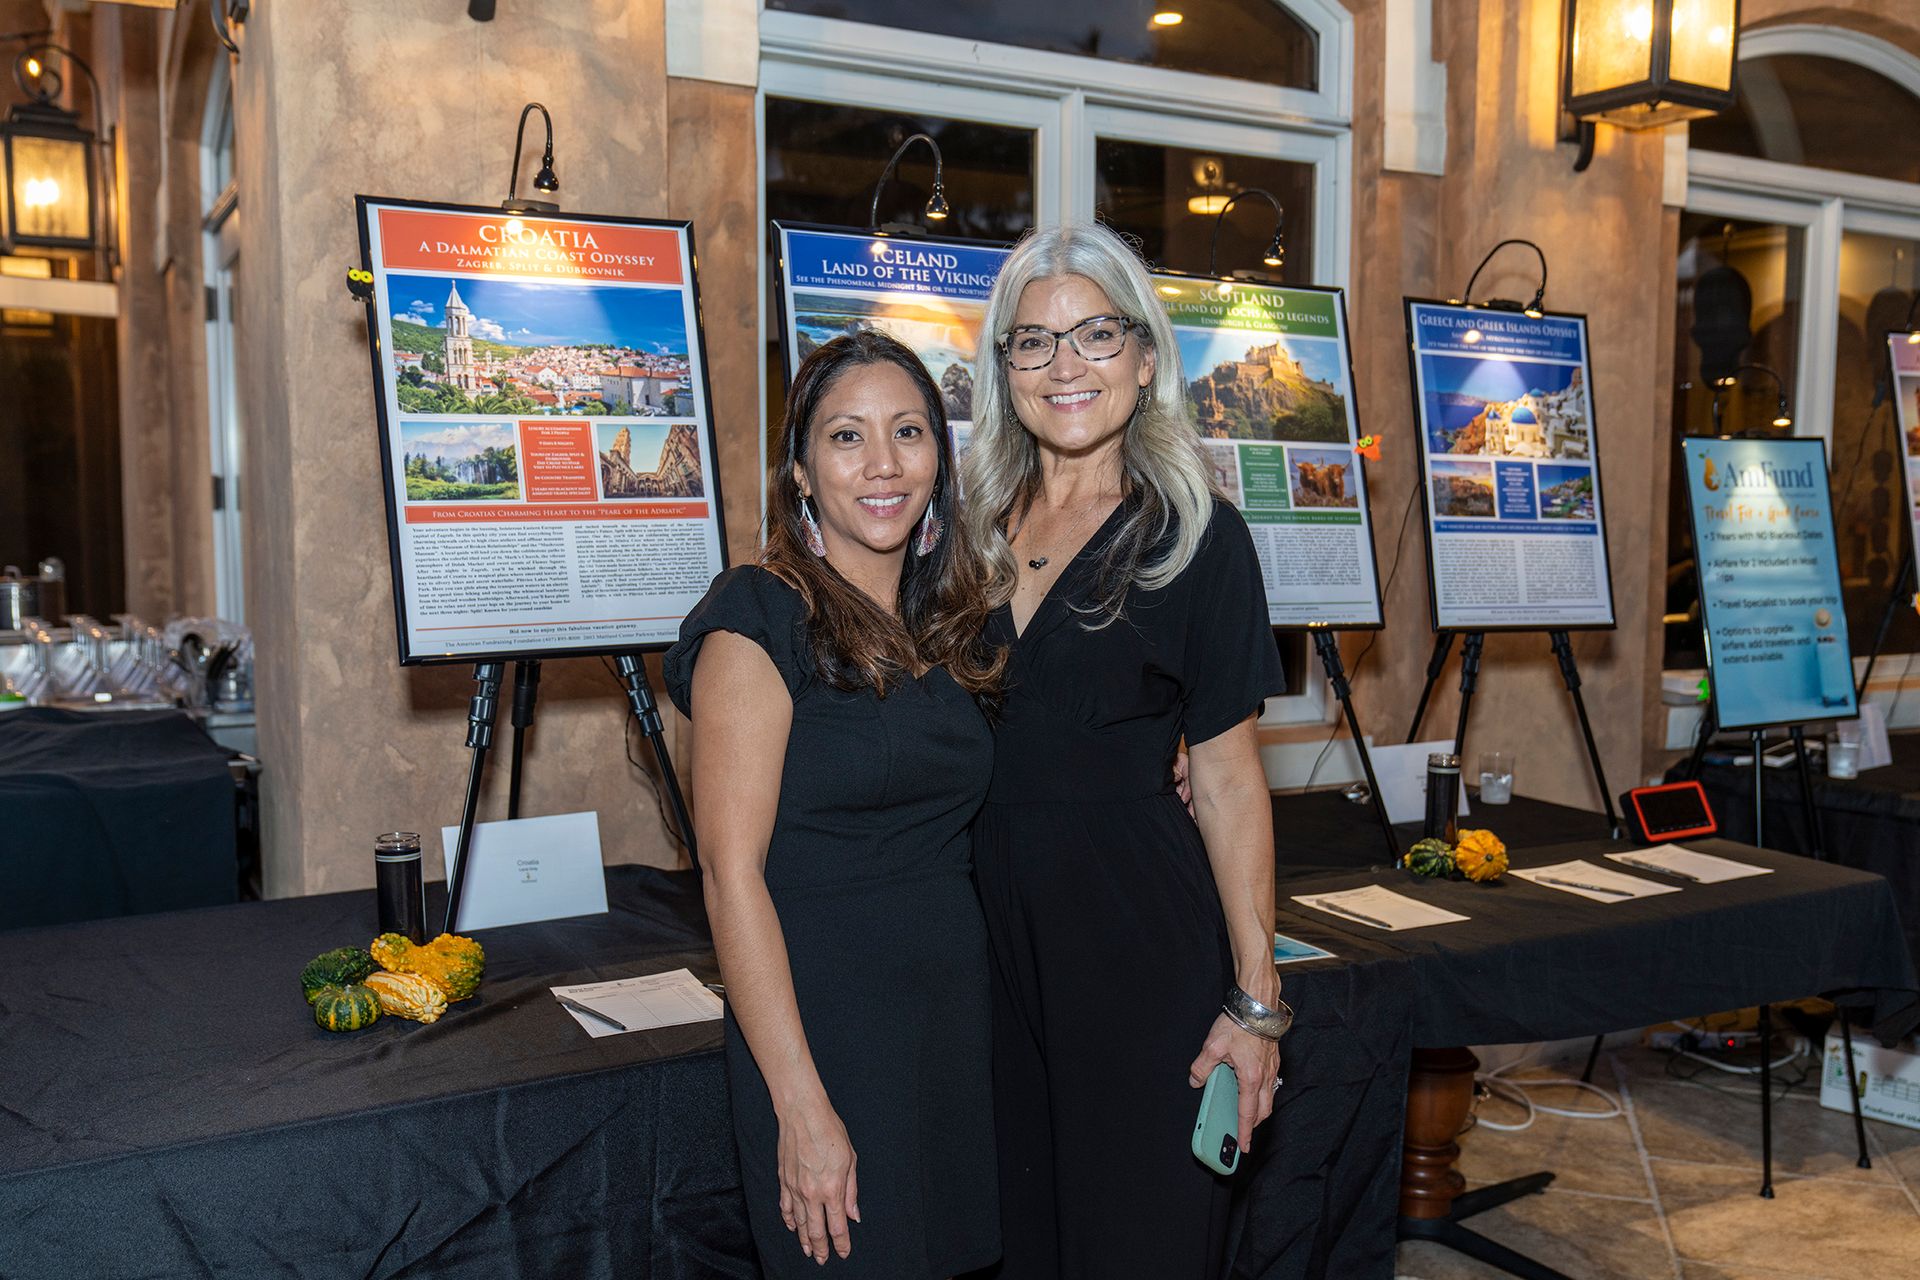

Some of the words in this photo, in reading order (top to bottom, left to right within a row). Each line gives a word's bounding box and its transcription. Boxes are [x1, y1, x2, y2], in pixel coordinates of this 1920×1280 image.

[478, 224, 600, 250] CROATIA
[419, 240, 431, 253] A
[436, 241, 529, 259] DALMATIAN
[535, 248, 586, 262] COAST
[590, 251, 655, 266] ODYSSEY
[872, 249, 958, 270] ICELAND
[509, 262, 540, 272] SPLIT
[543, 263, 552, 273] &
[556, 264, 625, 277] DUBROVNIK
[822, 259, 869, 277] LAND
[872, 265, 895, 279] OF
[899, 267, 931, 283] THE
[934, 269, 997, 288] VIKINGS
[796, 274, 809, 283] SEE
[811, 276, 825, 284] THE
[827, 277, 876, 288] PHENOMENAL
[877, 281, 915, 291] MIDNIGHT
[916, 283, 931, 292] SUN
[944, 286, 957, 294] THE
[1199, 288, 1285, 308] SCOTLAND
[1162, 301, 1177, 311] HE
[1179, 303, 1208, 314] LAND
[1209, 305, 1224, 315] OF
[1226, 307, 1261, 319] LOCHS
[1262, 310, 1285, 321] AND
[1286, 311, 1330, 325] LEGENDS
[1201, 317, 1244, 328] EDINBURGH
[1419, 313, 1453, 327] GREECE
[1455, 318, 1475, 329] AND
[1476, 319, 1504, 333] GREEK
[1506, 321, 1541, 335] ISLANDS
[1542, 324, 1578, 339] ODYSSEY
[1723, 460, 1814, 489] AmFund
[432, 510, 456, 518] FROM
[497, 509, 541, 517] CHARMING
